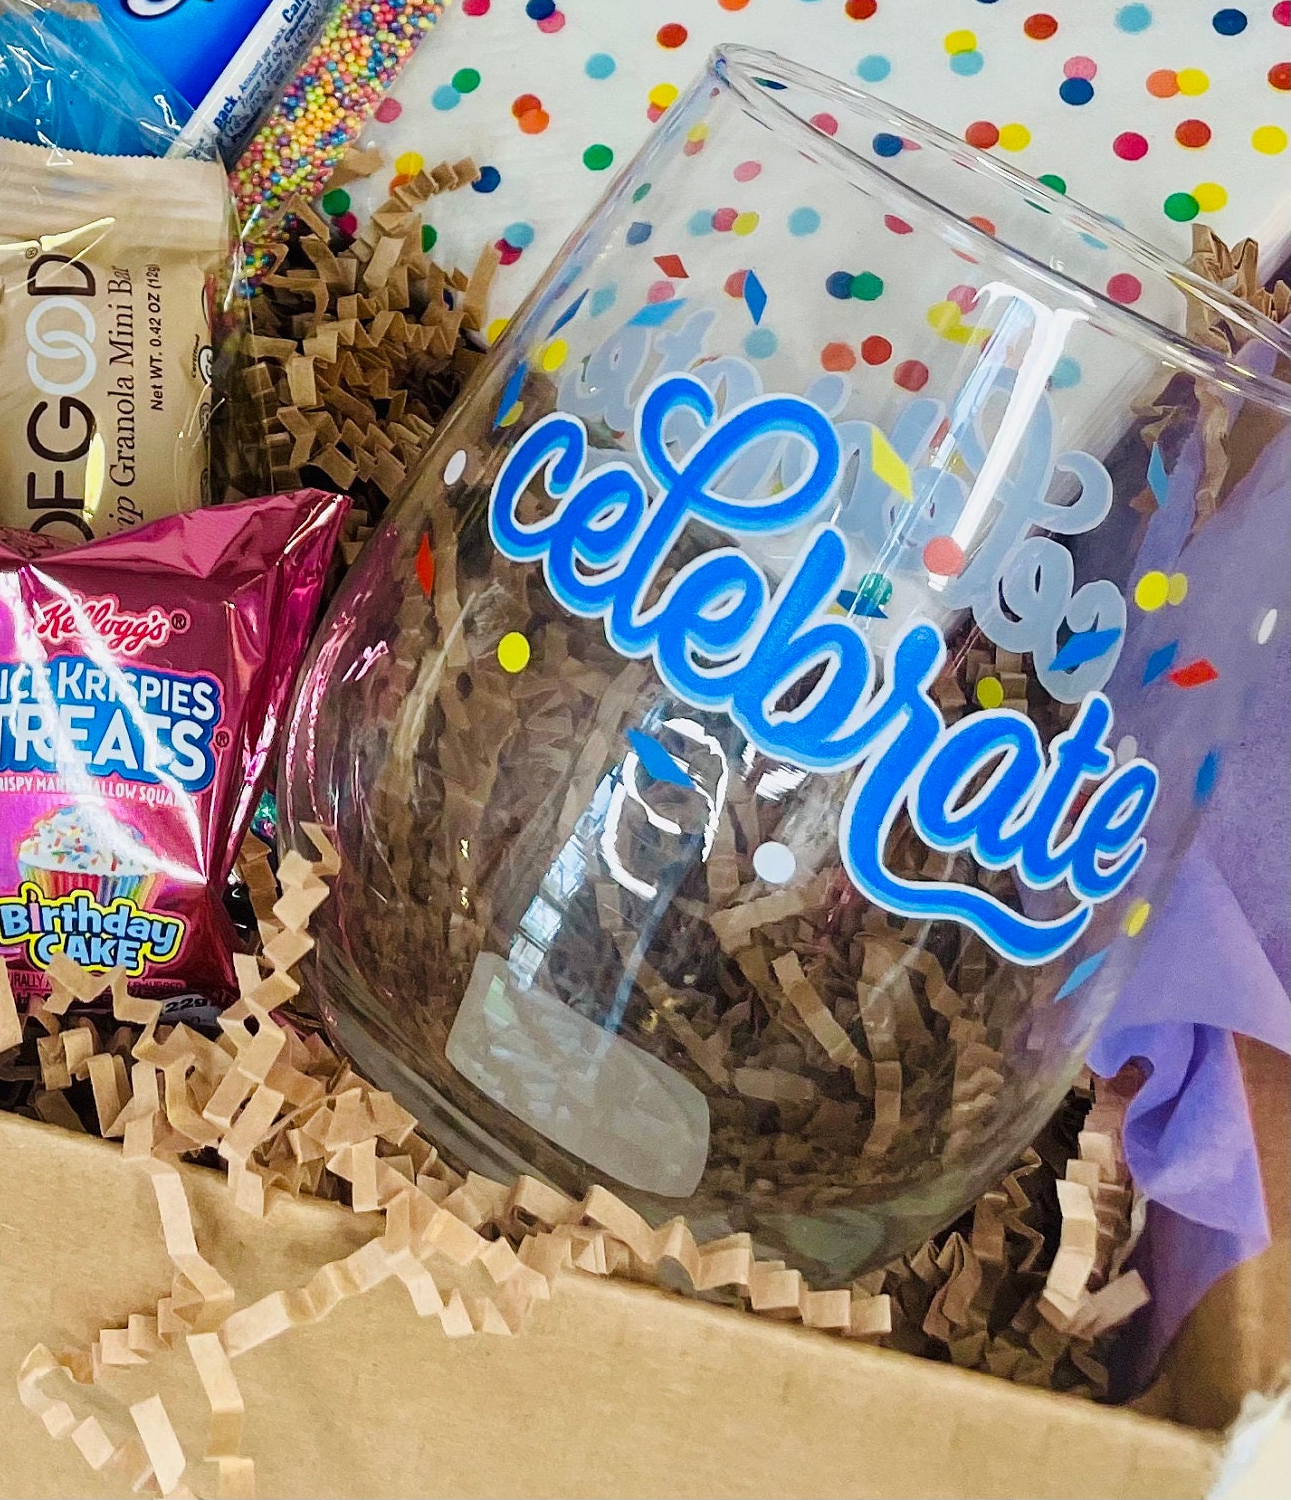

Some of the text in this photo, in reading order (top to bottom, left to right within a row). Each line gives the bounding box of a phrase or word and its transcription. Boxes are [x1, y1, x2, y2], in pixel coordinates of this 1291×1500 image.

[107, 265, 133, 297] Bar
[147, 293, 161, 314] OZ
[108, 304, 134, 369] Mini
[148, 317, 162, 348] 0.42
[149, 352, 163, 381] WT.
[150, 386, 163, 411] Net
[107, 374, 136, 488] Granola
[491, 374, 1158, 965] celebrate
[36, 933, 141, 969] CAKE
